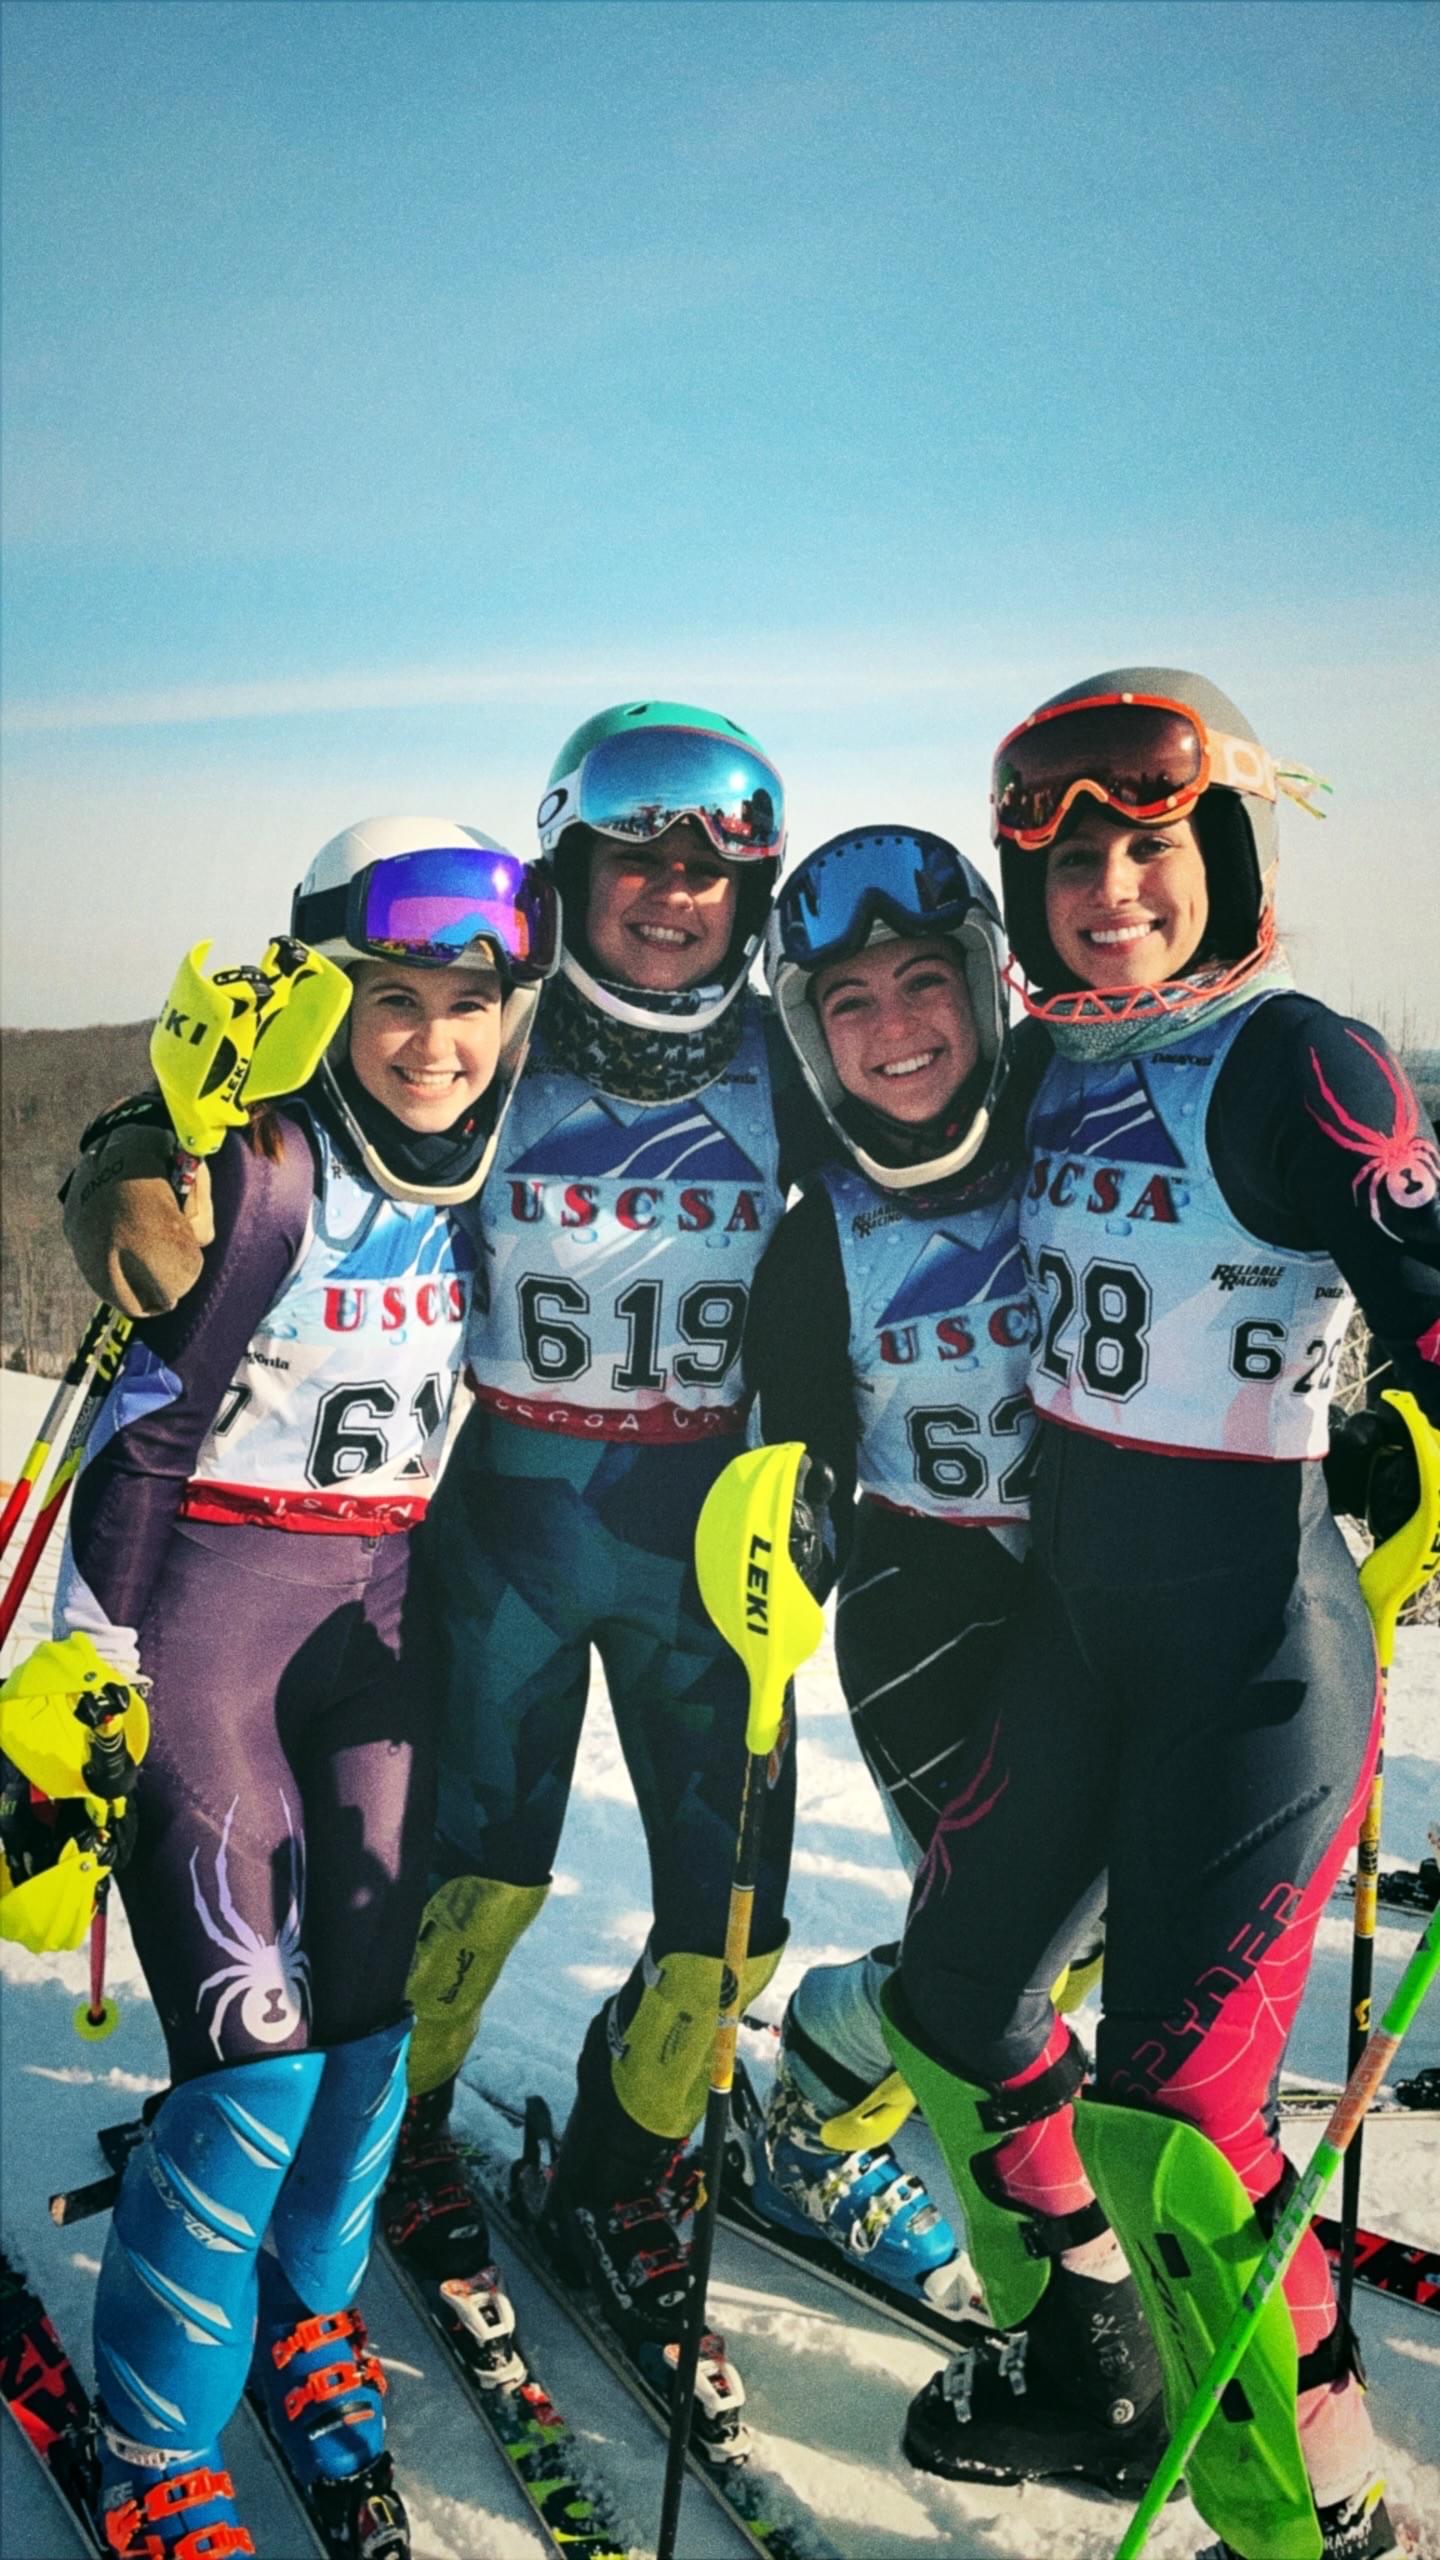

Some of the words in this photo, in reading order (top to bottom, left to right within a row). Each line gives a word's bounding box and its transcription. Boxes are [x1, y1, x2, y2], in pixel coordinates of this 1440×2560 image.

[220, 1056, 249, 1103] LEKI
[506, 1180, 761, 1232] USCSA
[1210, 1263, 1286, 1281] RELIABLE
[1218, 1274, 1280, 1292] RACING
[515, 1272, 751, 1392] 619
[305, 1372, 458, 1490] 61
[745, 1533, 772, 1637] LEKI
